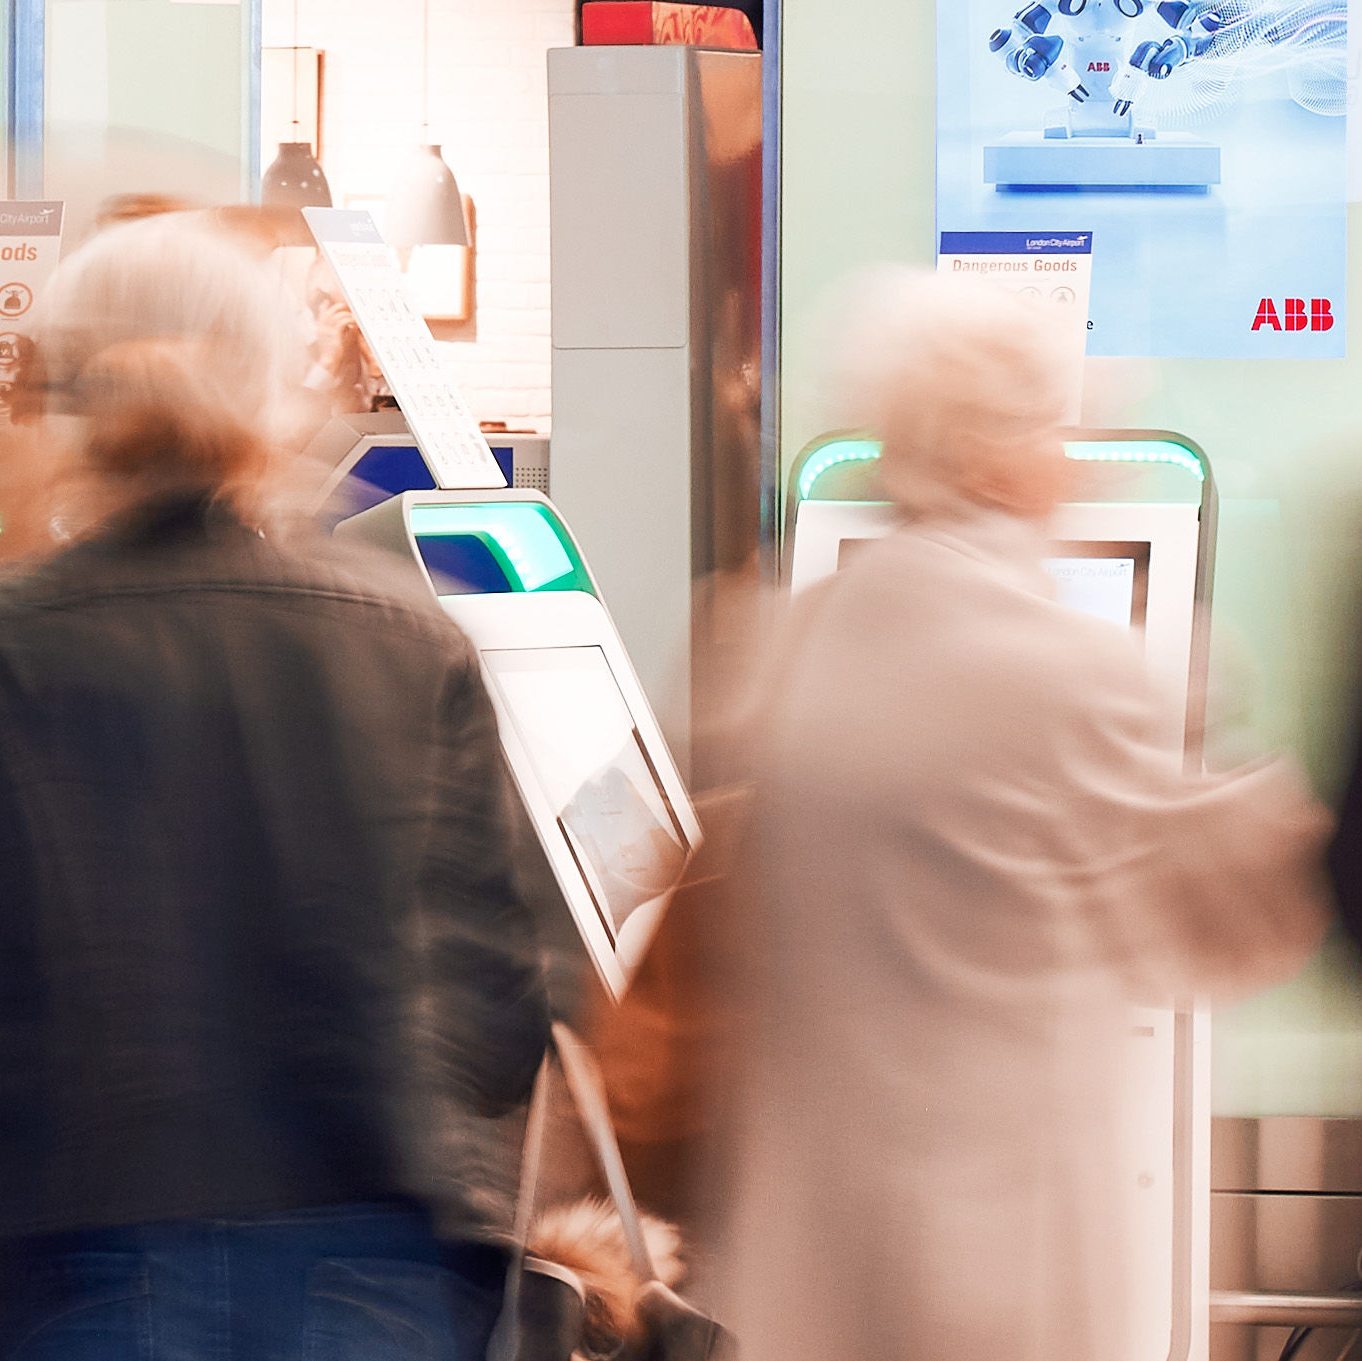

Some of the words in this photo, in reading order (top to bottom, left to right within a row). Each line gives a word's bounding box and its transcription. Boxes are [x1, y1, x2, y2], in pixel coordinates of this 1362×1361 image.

[1087, 62, 1110, 72] ABB
[953, 259, 1028, 275] Dangerous
[1034, 259, 1077, 272] Goods
[1251, 298, 1334, 331] ABB
